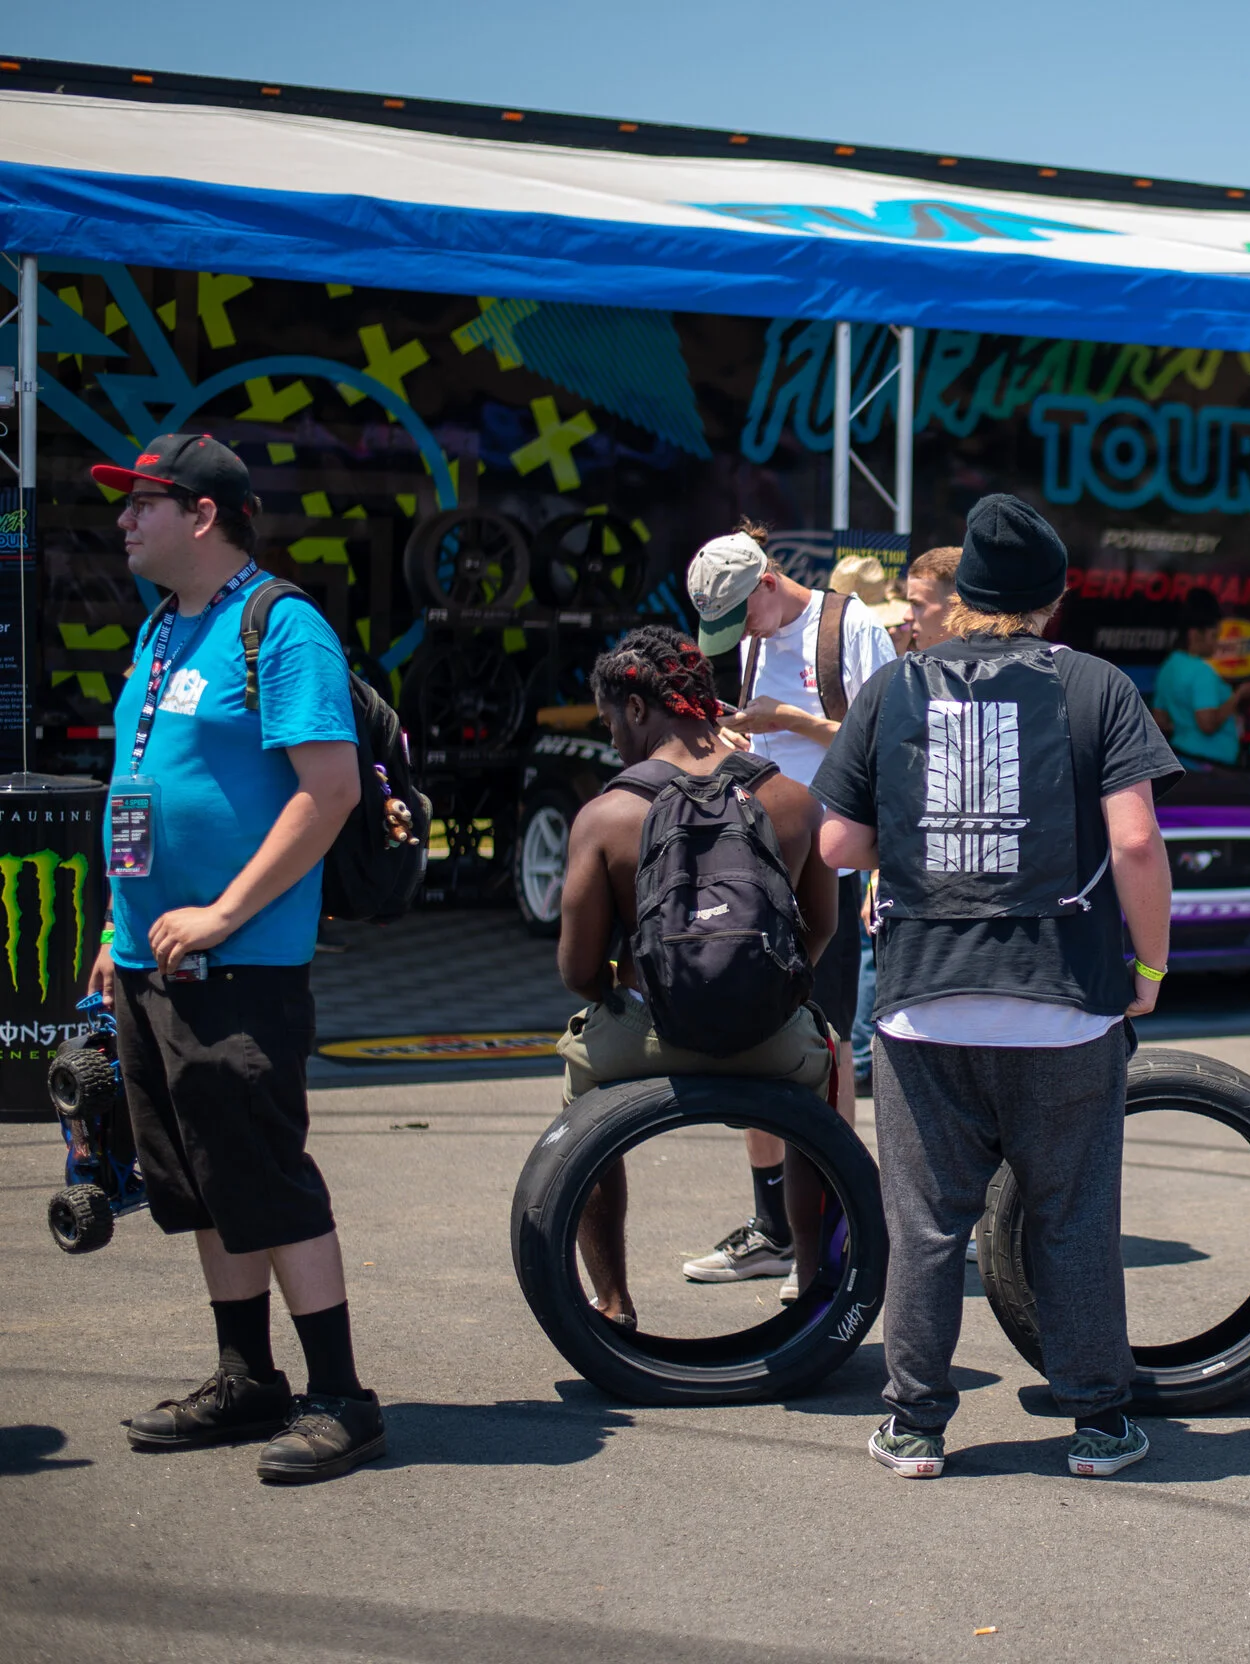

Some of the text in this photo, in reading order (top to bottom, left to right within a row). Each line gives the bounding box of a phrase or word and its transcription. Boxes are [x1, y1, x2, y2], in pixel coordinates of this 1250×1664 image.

[1103, 530, 1222, 553] POWERED BY
[917, 817, 1027, 829] NITTO
[0, 1020, 100, 1047] ONSTE
[0, 1050, 57, 1060] NER
